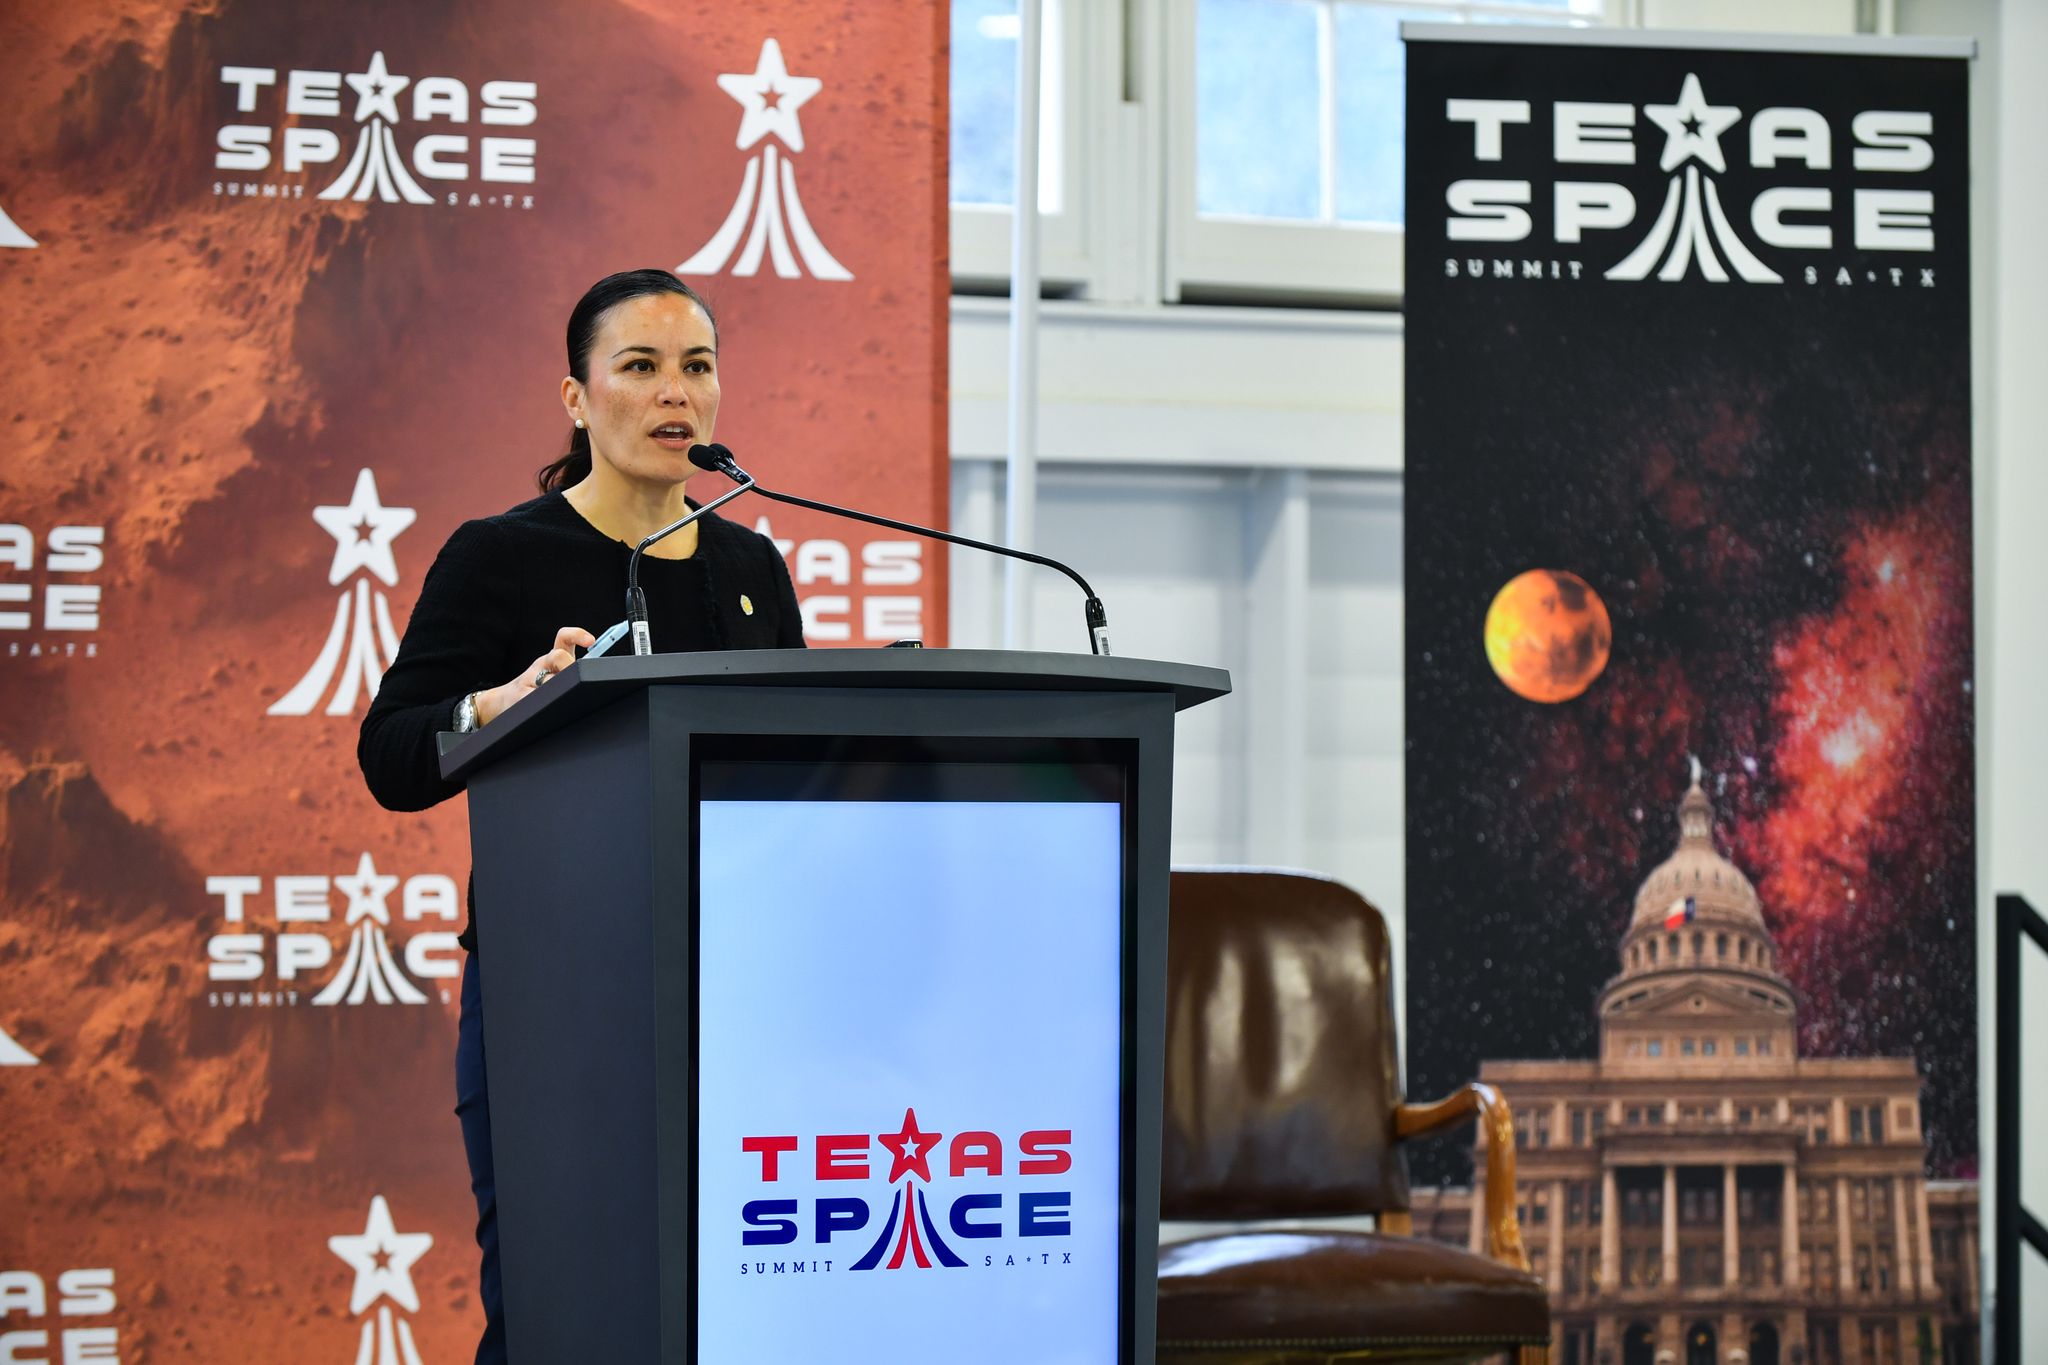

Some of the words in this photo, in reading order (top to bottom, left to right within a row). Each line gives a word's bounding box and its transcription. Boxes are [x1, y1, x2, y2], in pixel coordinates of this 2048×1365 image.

[220, 51, 538, 126] TEXAS
[1446, 72, 1935, 173] TEXAS
[213, 181, 304, 199] SUMMIT
[215, 117, 536, 204] SPACE
[1446, 165, 1935, 284] SPACE
[1445, 259, 1584, 280] SUMMIT
[205, 851, 459, 926] TEXA
[207, 919, 460, 1006] SPAC
[208, 991, 298, 1007] SUMMIT
[742, 1107, 1072, 1184] TEXAS
[742, 1180, 1072, 1271] SPACE
[741, 1260, 833, 1275] SUMMIT
